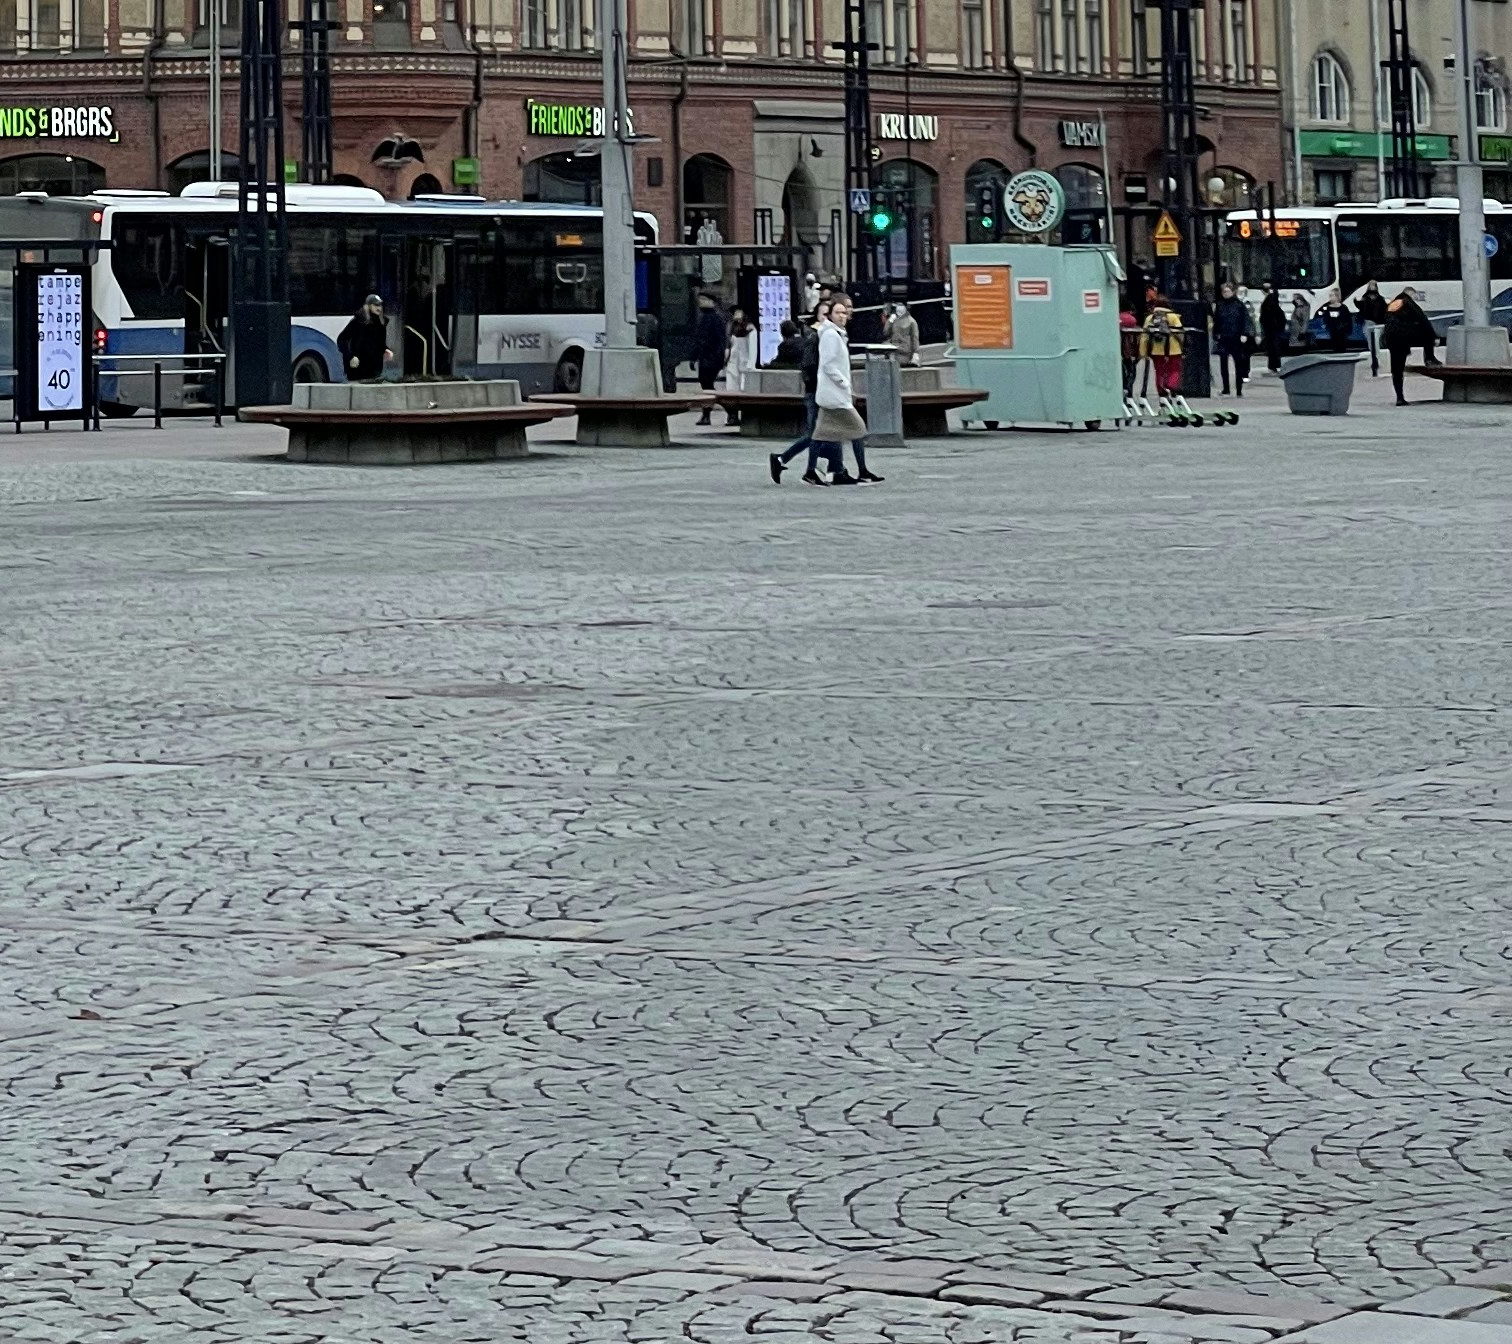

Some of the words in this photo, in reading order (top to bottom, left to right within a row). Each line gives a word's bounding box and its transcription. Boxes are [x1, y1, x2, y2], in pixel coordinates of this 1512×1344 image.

[39, 108, 48, 136] &
[51, 107, 112, 137] BRGRS
[531, 104, 584, 135] FRIENDS
[881, 113, 938, 140] KRUUNU
[1240, 220, 1251, 238] 8
[38, 277, 81, 293] tampe
[38, 309, 81, 328] zhapp
[38, 325, 81, 346] ening
[501, 333, 541, 349] NYSSE
[47, 369, 71, 389] 40
